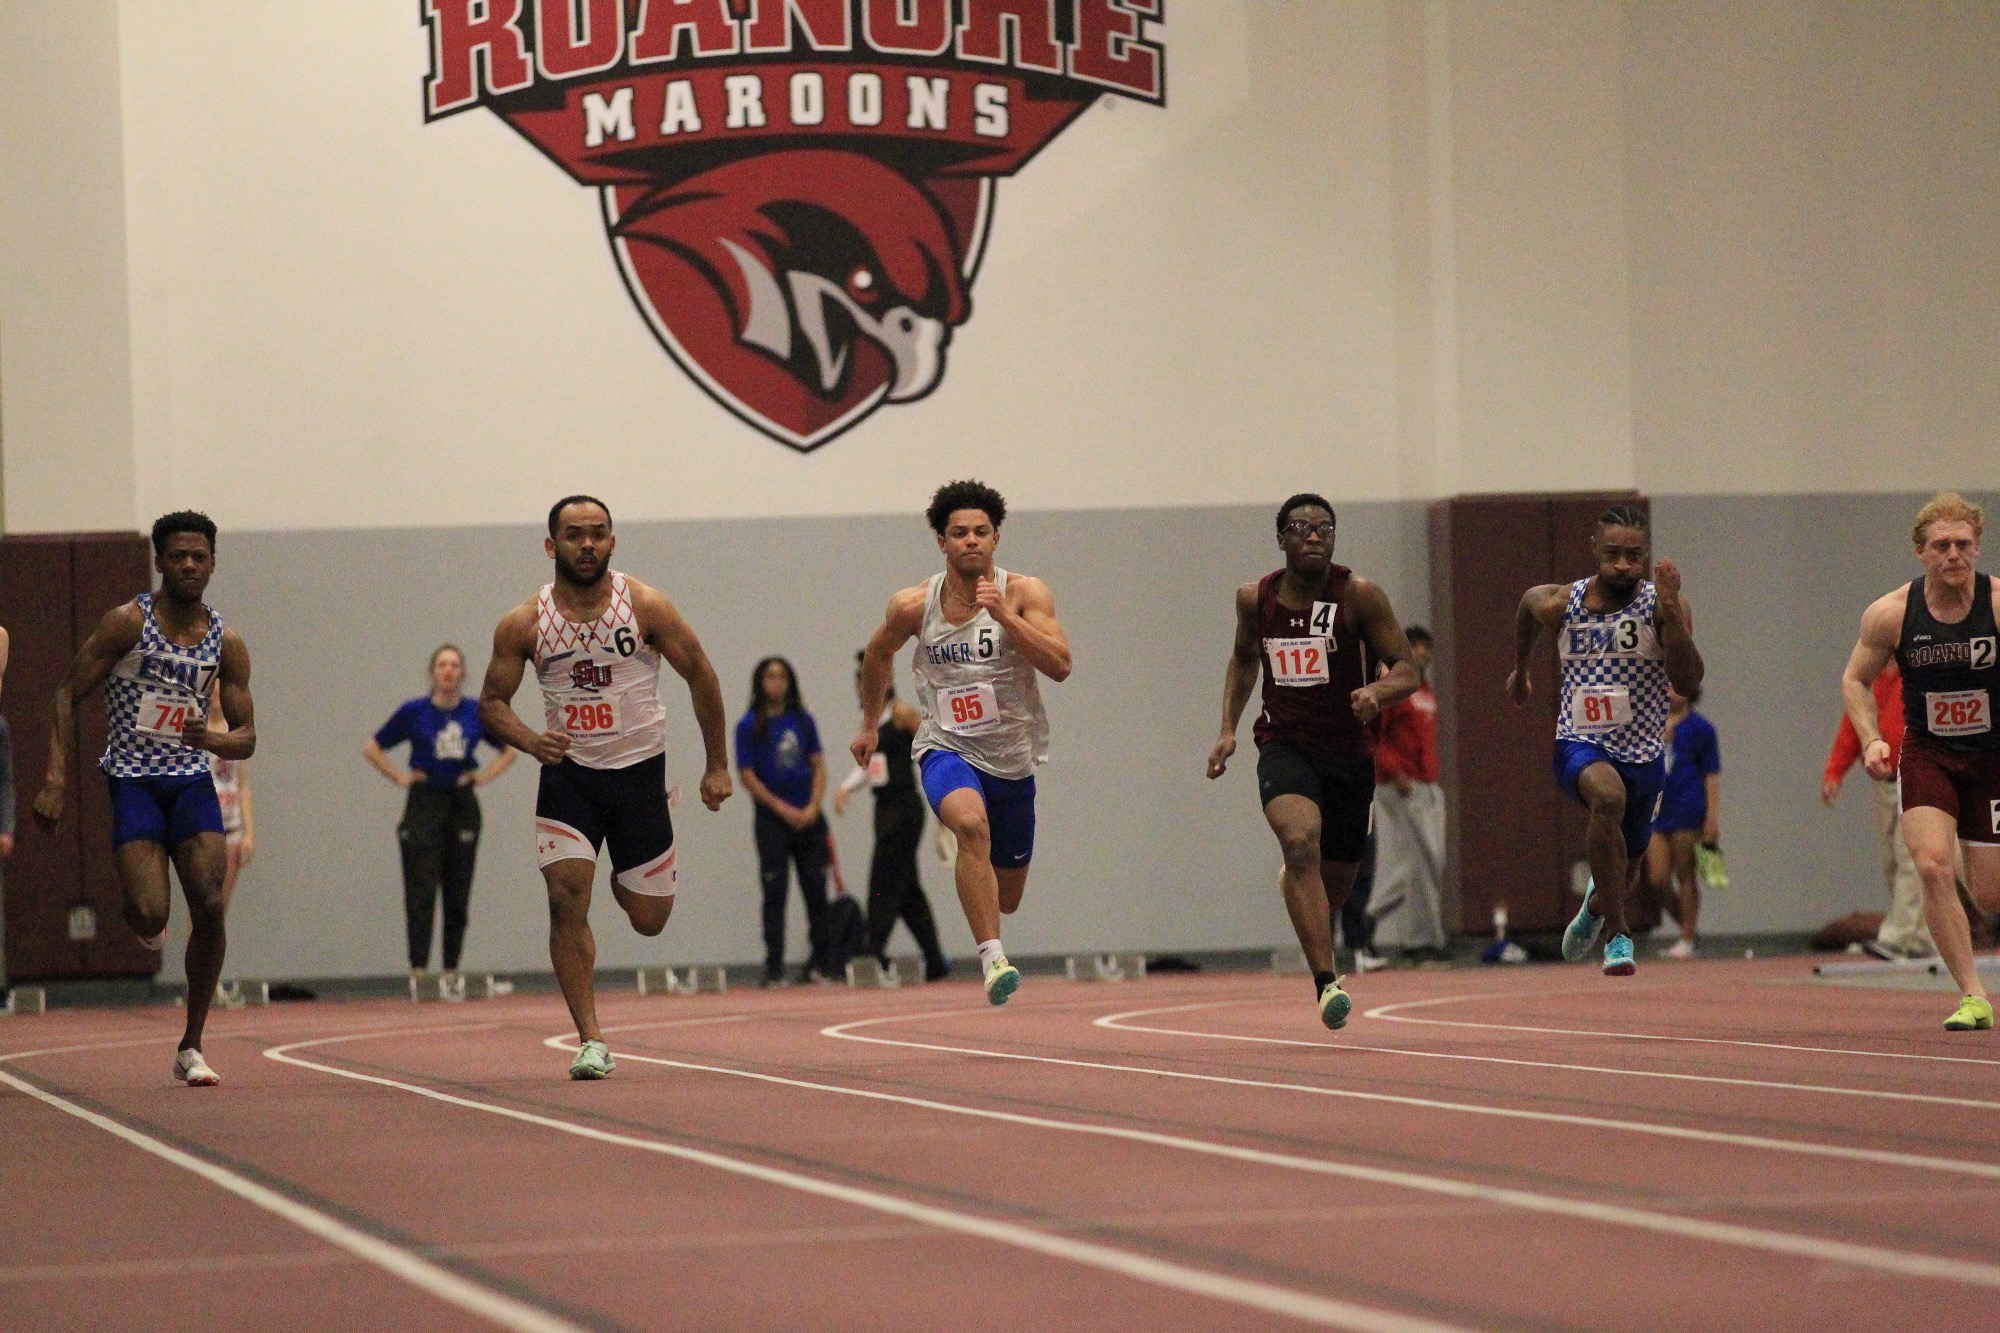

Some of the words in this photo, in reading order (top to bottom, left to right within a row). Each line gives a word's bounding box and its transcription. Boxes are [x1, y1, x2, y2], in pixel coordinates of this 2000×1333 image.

[582, 72, 1009, 148] MAROONS
[1313, 604, 1331, 634] 4
[614, 626, 636, 658] 6
[978, 628, 993, 659] 5
[1567, 627, 1618, 656] EM
[1619, 619, 1639, 650] 3
[926, 642, 975, 665] GENER
[1275, 647, 1321, 676] 112
[1906, 642, 1972, 668] ROANO
[1974, 639, 1992, 668] 2
[200, 665, 217, 693] 7
[153, 704, 186, 733] 74
[564, 703, 614, 731] 296
[951, 693, 984, 724] 95
[1583, 695, 1614, 722] 81
[1933, 698, 1983, 726] 262
